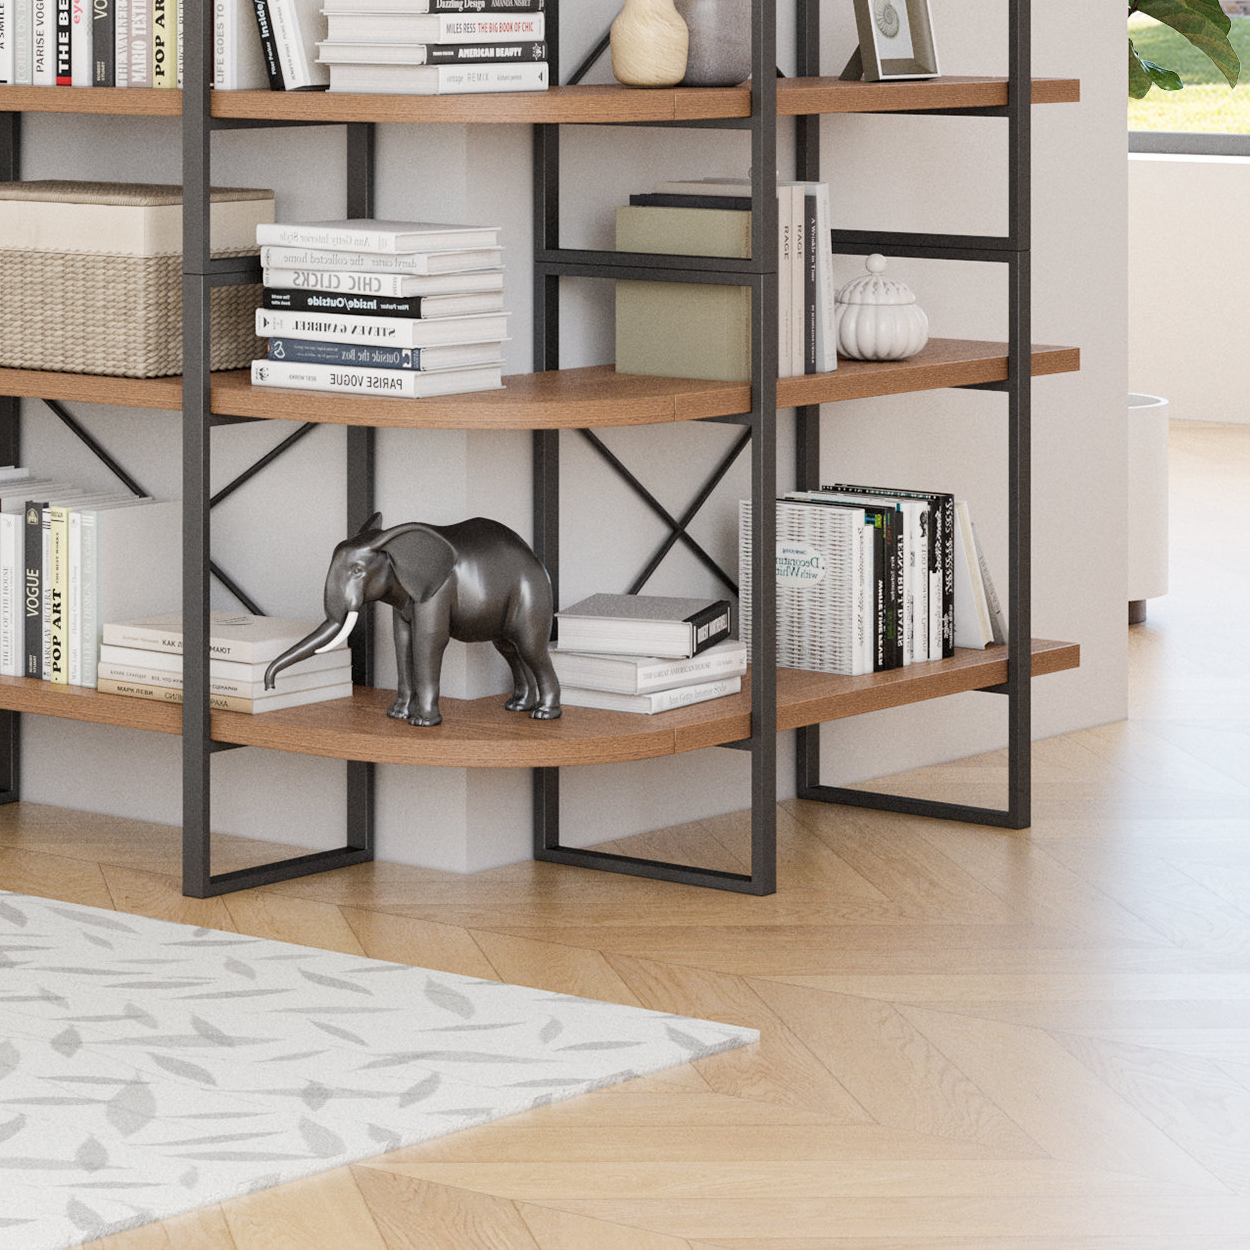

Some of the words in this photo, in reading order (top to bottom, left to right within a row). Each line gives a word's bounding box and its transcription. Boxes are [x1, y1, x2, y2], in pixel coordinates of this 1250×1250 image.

[216, 3, 225, 18] TO
[36, 30, 44, 73] PARISE
[58, 31, 69, 74] THE
[155, 35, 165, 77] POP
[216, 22, 225, 55] GOES
[458, 48, 495, 58] AMERICAN
[496, 47, 523, 57] BEAUTY
[216, 60, 225, 84] LIFE
[27, 568, 39, 618] VOGUE
[52, 588, 61, 630] ART
[52, 636, 61, 673] POP
[162, 639, 176, 647] КАК
[117, 685, 134, 694] МАРК
[135, 687, 154, 696] ЛЕВИ
